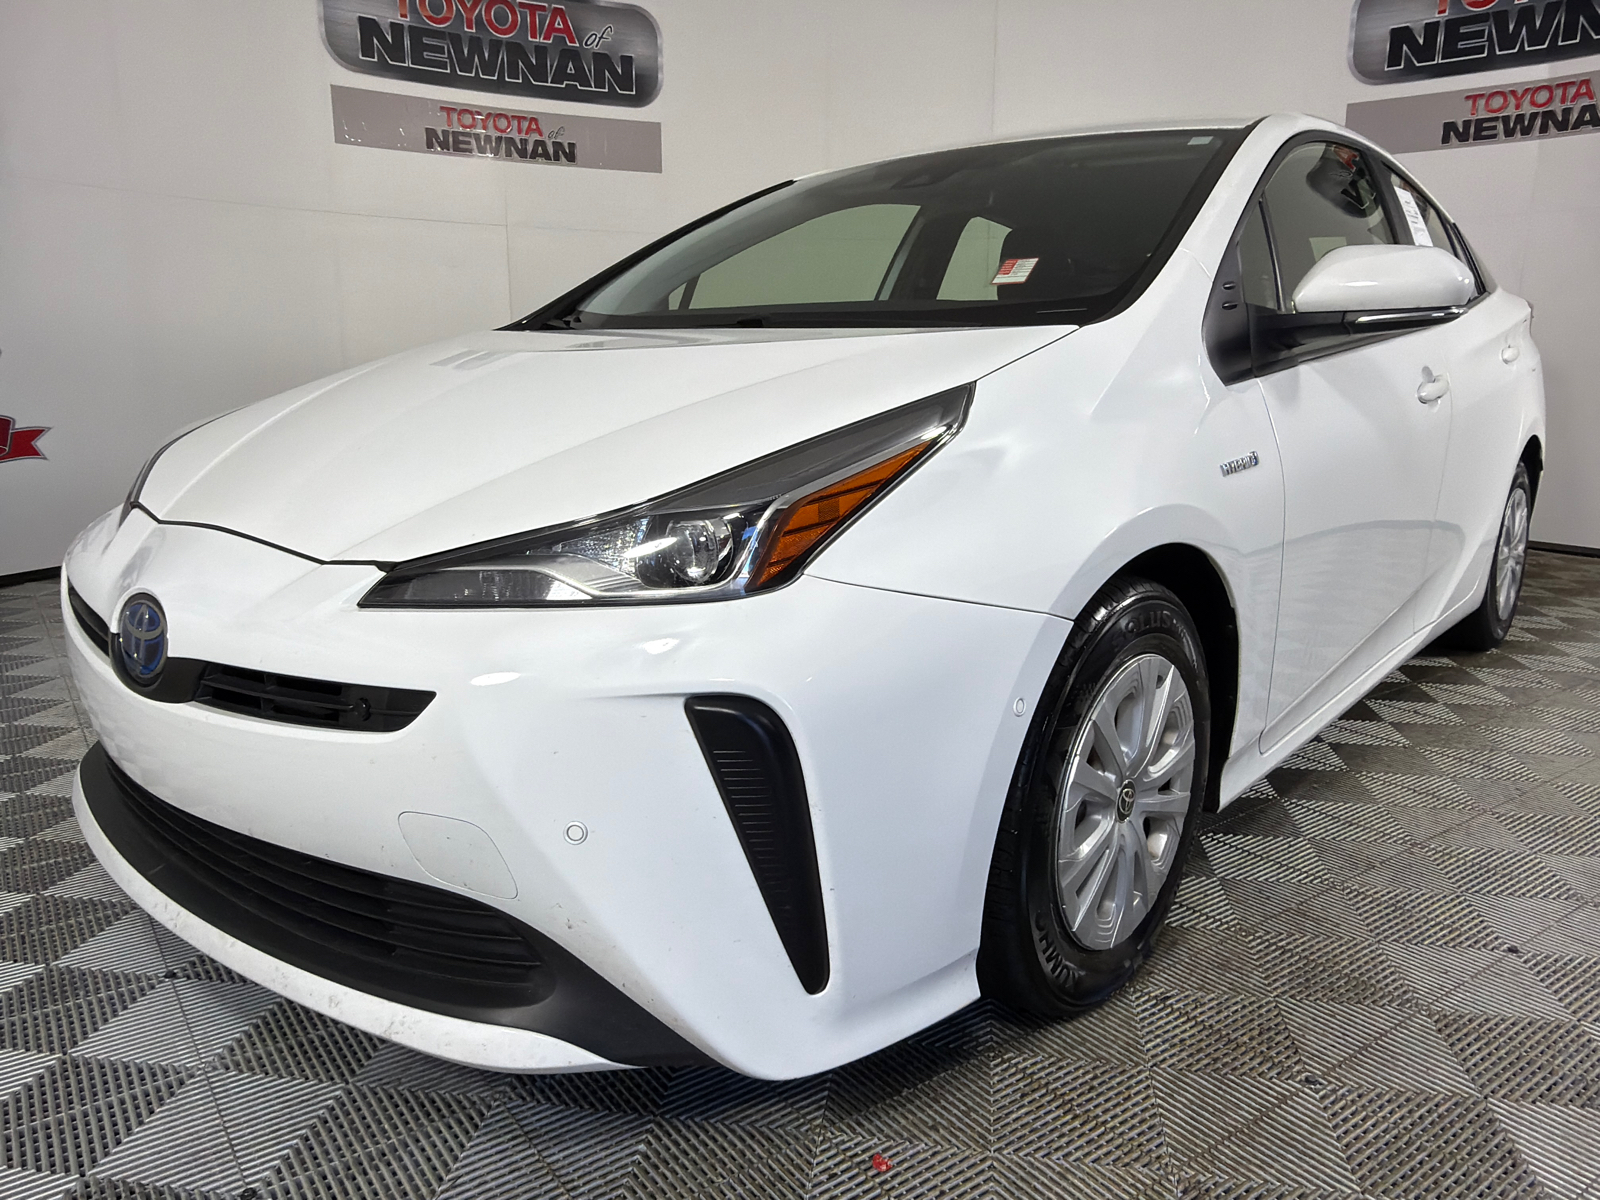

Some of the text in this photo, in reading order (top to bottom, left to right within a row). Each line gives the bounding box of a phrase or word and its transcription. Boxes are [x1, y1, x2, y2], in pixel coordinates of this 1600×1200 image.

[357, 14, 636, 94] NEWNAN
[583, 24, 613, 49] of
[1464, 77, 1597, 116] TOYOTA
[439, 105, 566, 141] TOYOTA of
[424, 126, 578, 165] NEWNAN
